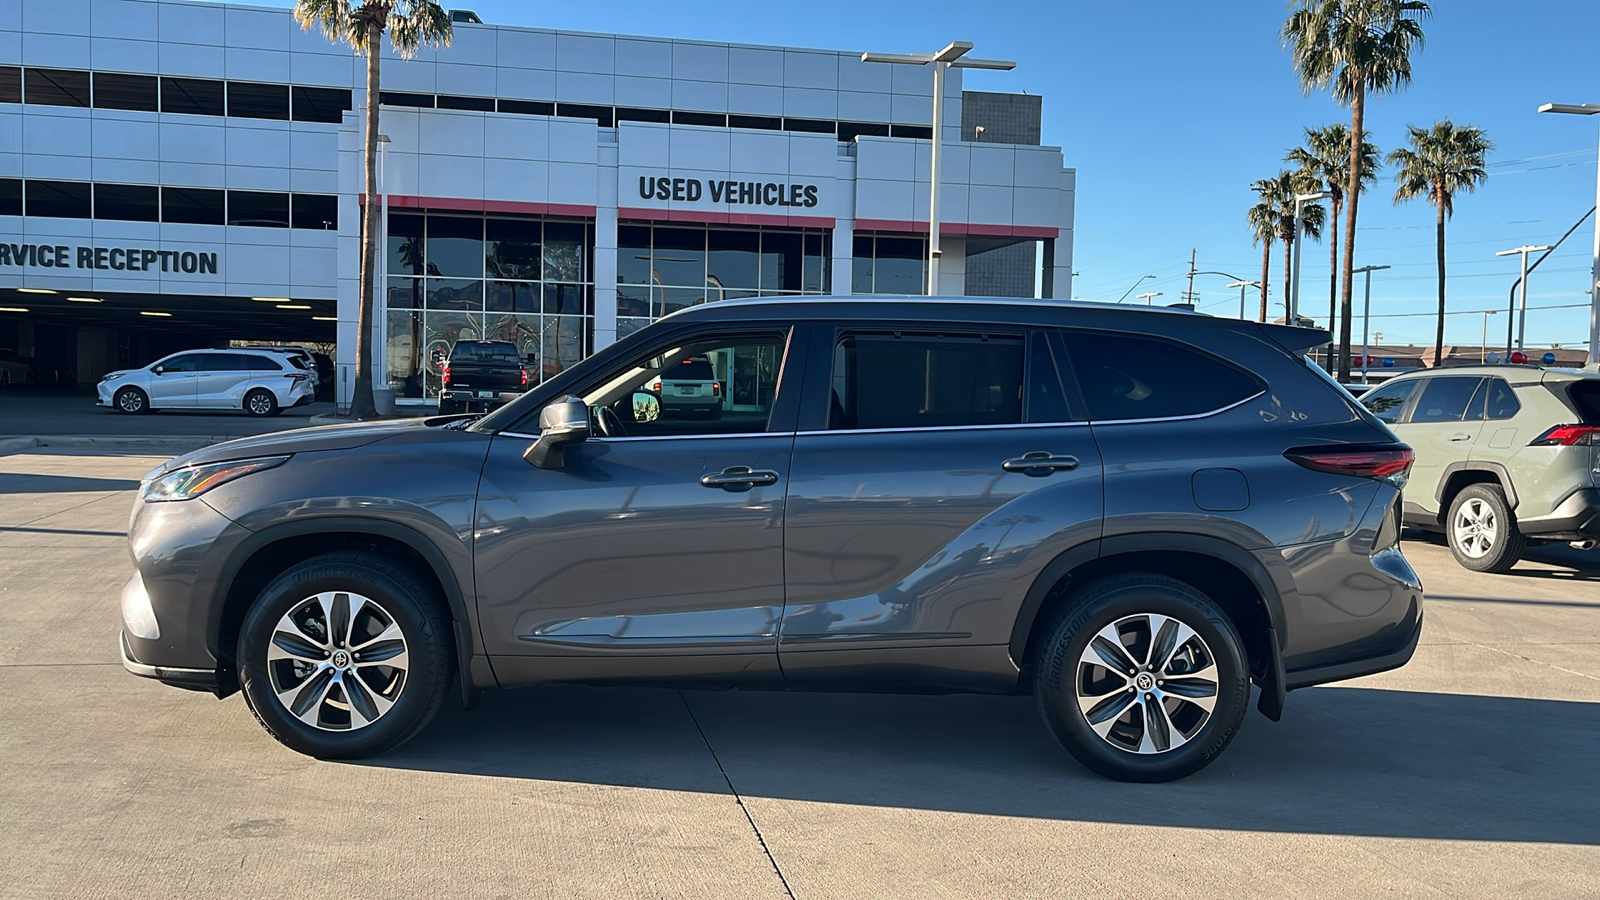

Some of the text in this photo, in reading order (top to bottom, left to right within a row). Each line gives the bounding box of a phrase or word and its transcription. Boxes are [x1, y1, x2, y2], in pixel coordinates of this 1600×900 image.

[639, 176, 818, 208] USED VEHICLES
[0, 243, 218, 274] RVICE RECEPTION
